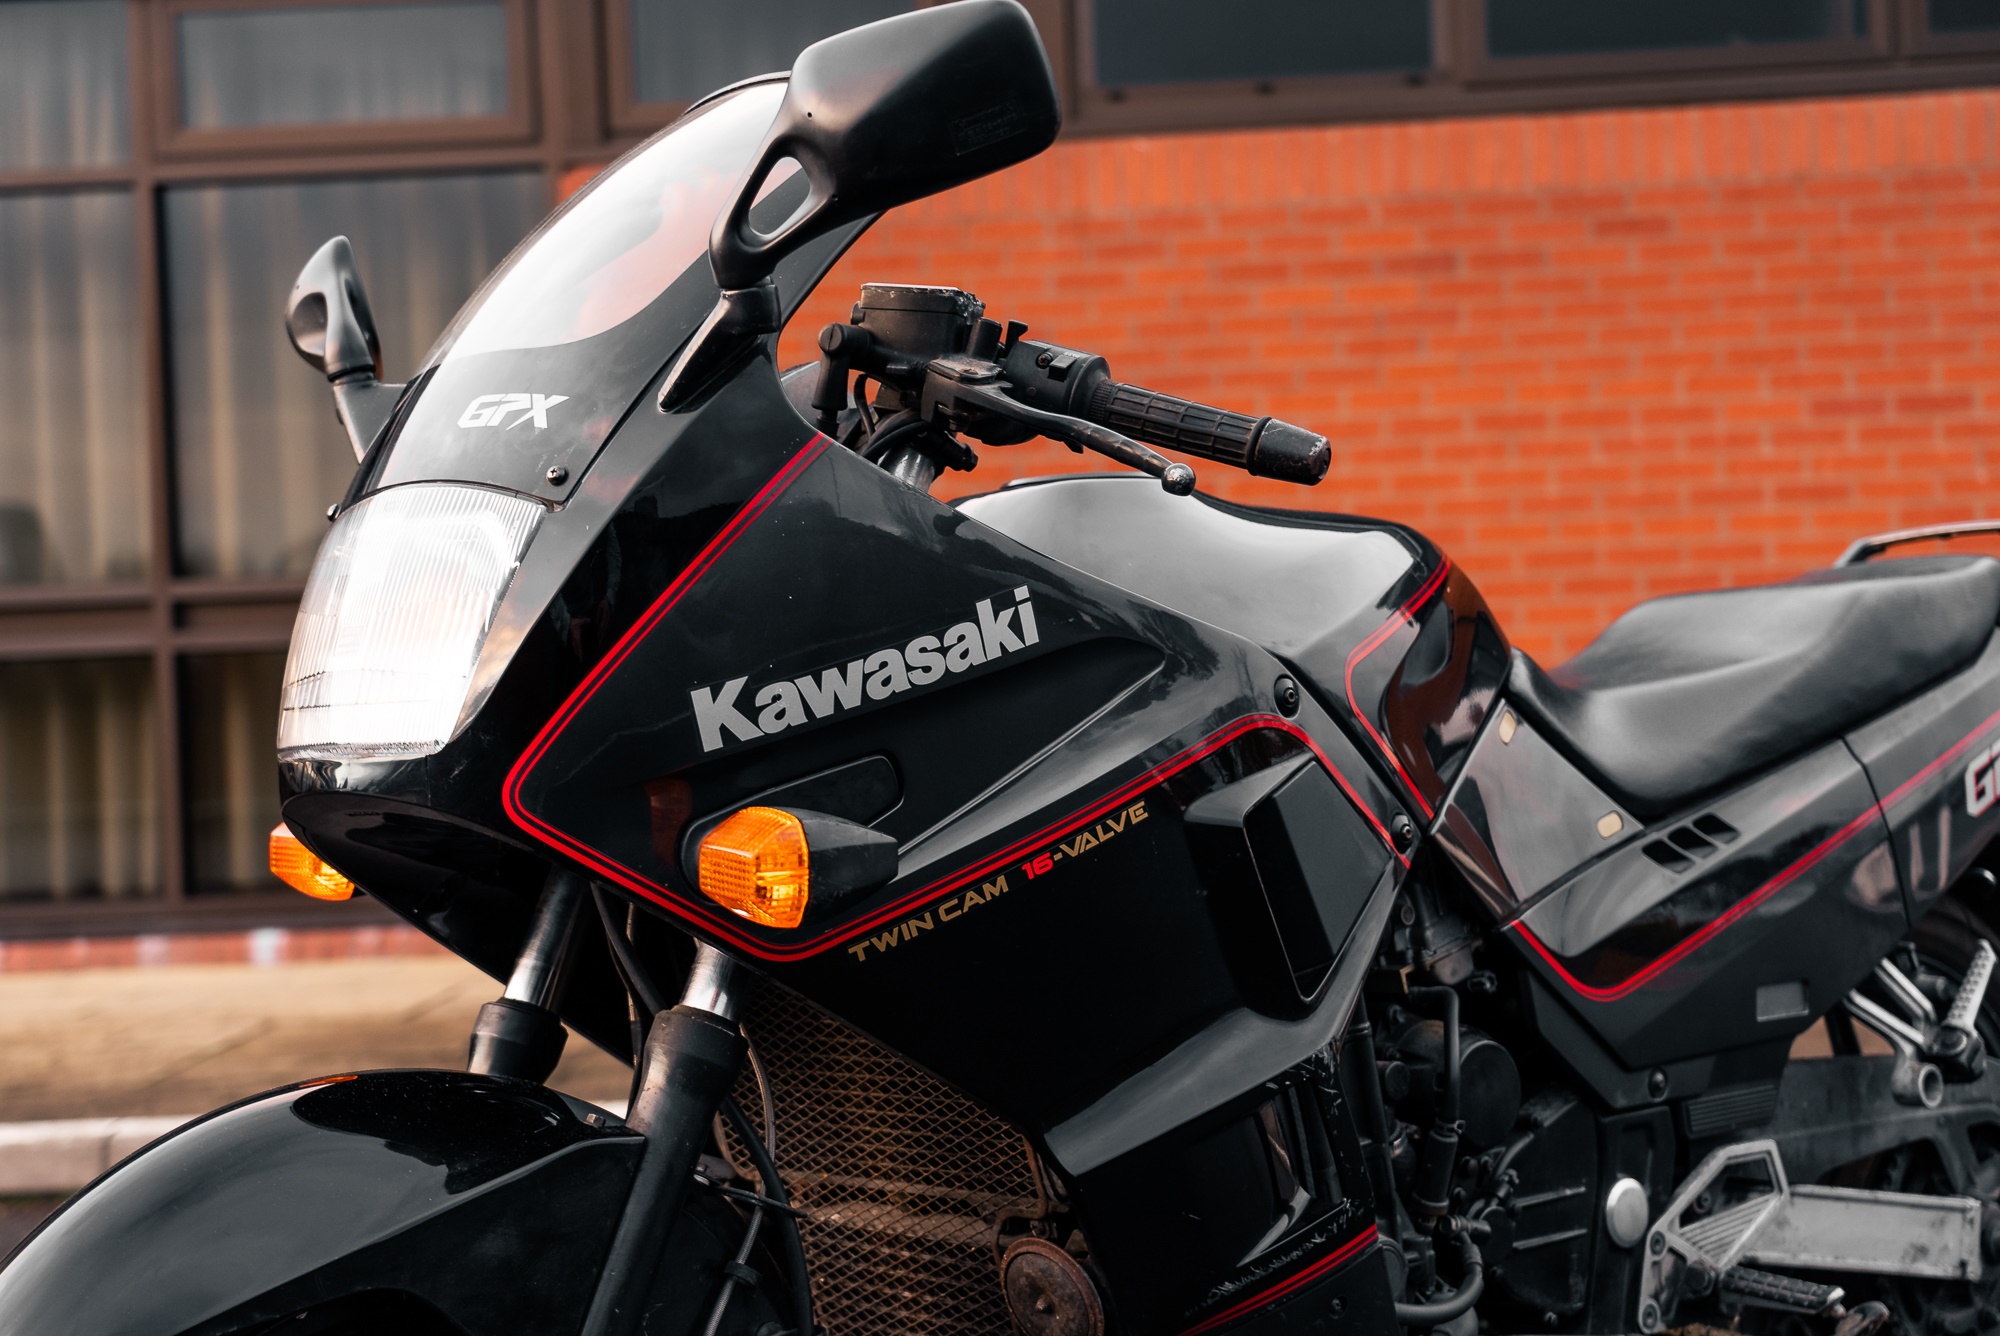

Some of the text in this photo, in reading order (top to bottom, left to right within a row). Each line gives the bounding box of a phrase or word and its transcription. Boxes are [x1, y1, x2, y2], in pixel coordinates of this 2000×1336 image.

[457, 393, 569, 430] GPX
[690, 585, 1039, 752] Kawasaki
[848, 800, 1149, 962] TWIN CAM 16-VALVE
